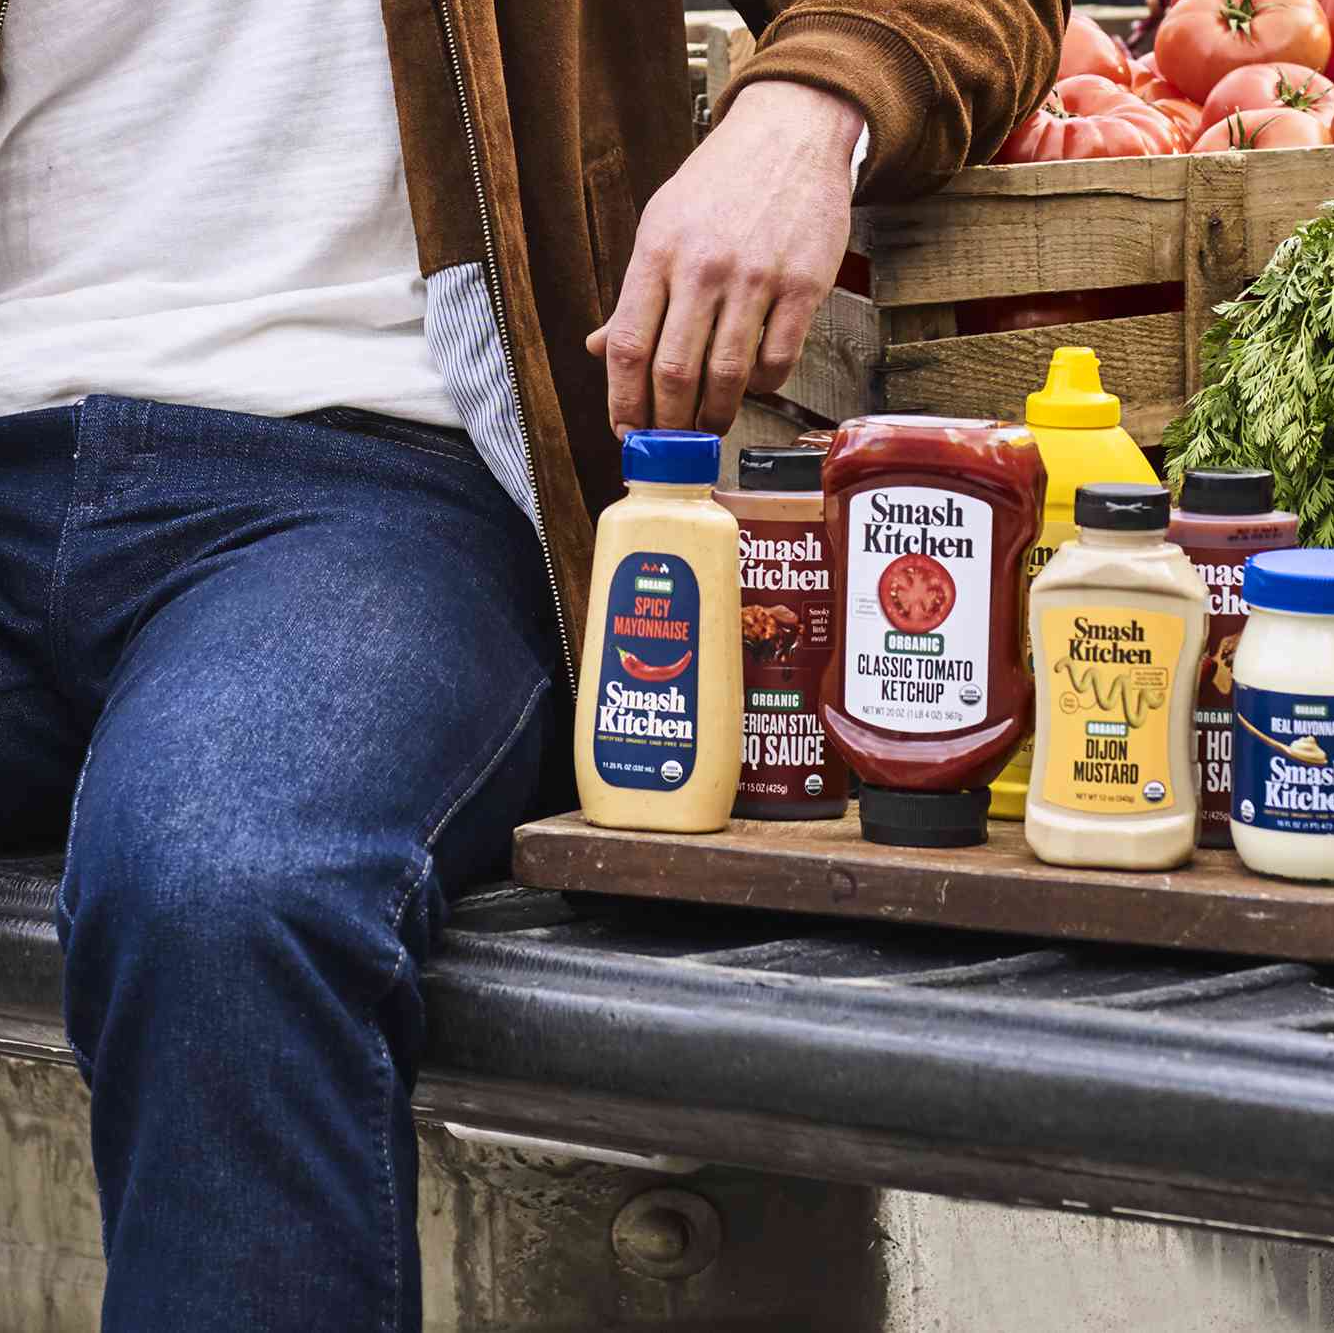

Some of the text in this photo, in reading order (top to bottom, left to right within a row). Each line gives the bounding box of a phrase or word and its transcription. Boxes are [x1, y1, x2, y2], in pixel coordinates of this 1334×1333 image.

[871, 492, 963, 527] Smash
[739, 530, 822, 561] Smash
[863, 523, 974, 558] Kitchen
[1195, 563, 1244, 586] mas
[634, 597, 671, 618] SPICY
[614, 616, 690, 641] MAYONNAISE
[1074, 616, 1145, 642] Smash
[888, 634, 940, 652] ORGANIC
[1068, 638, 1152, 664] Kitchen
[858, 654, 973, 682] CLASSIC TOMATO
[606, 681, 685, 713] Smash
[752, 693, 799, 707] ORGANIC
[881, 680, 944, 704] KETCHUP
[598, 706, 693, 739] Kitchen
[743, 713, 786, 734] ERICAN
[1198, 712, 1233, 724] ORGANI
[1271, 717, 1292, 734] REAL
[765, 735, 825, 766] SAUCE
[1085, 739, 1128, 761] DIJON
[1073, 761, 1139, 784] MUSTARD
